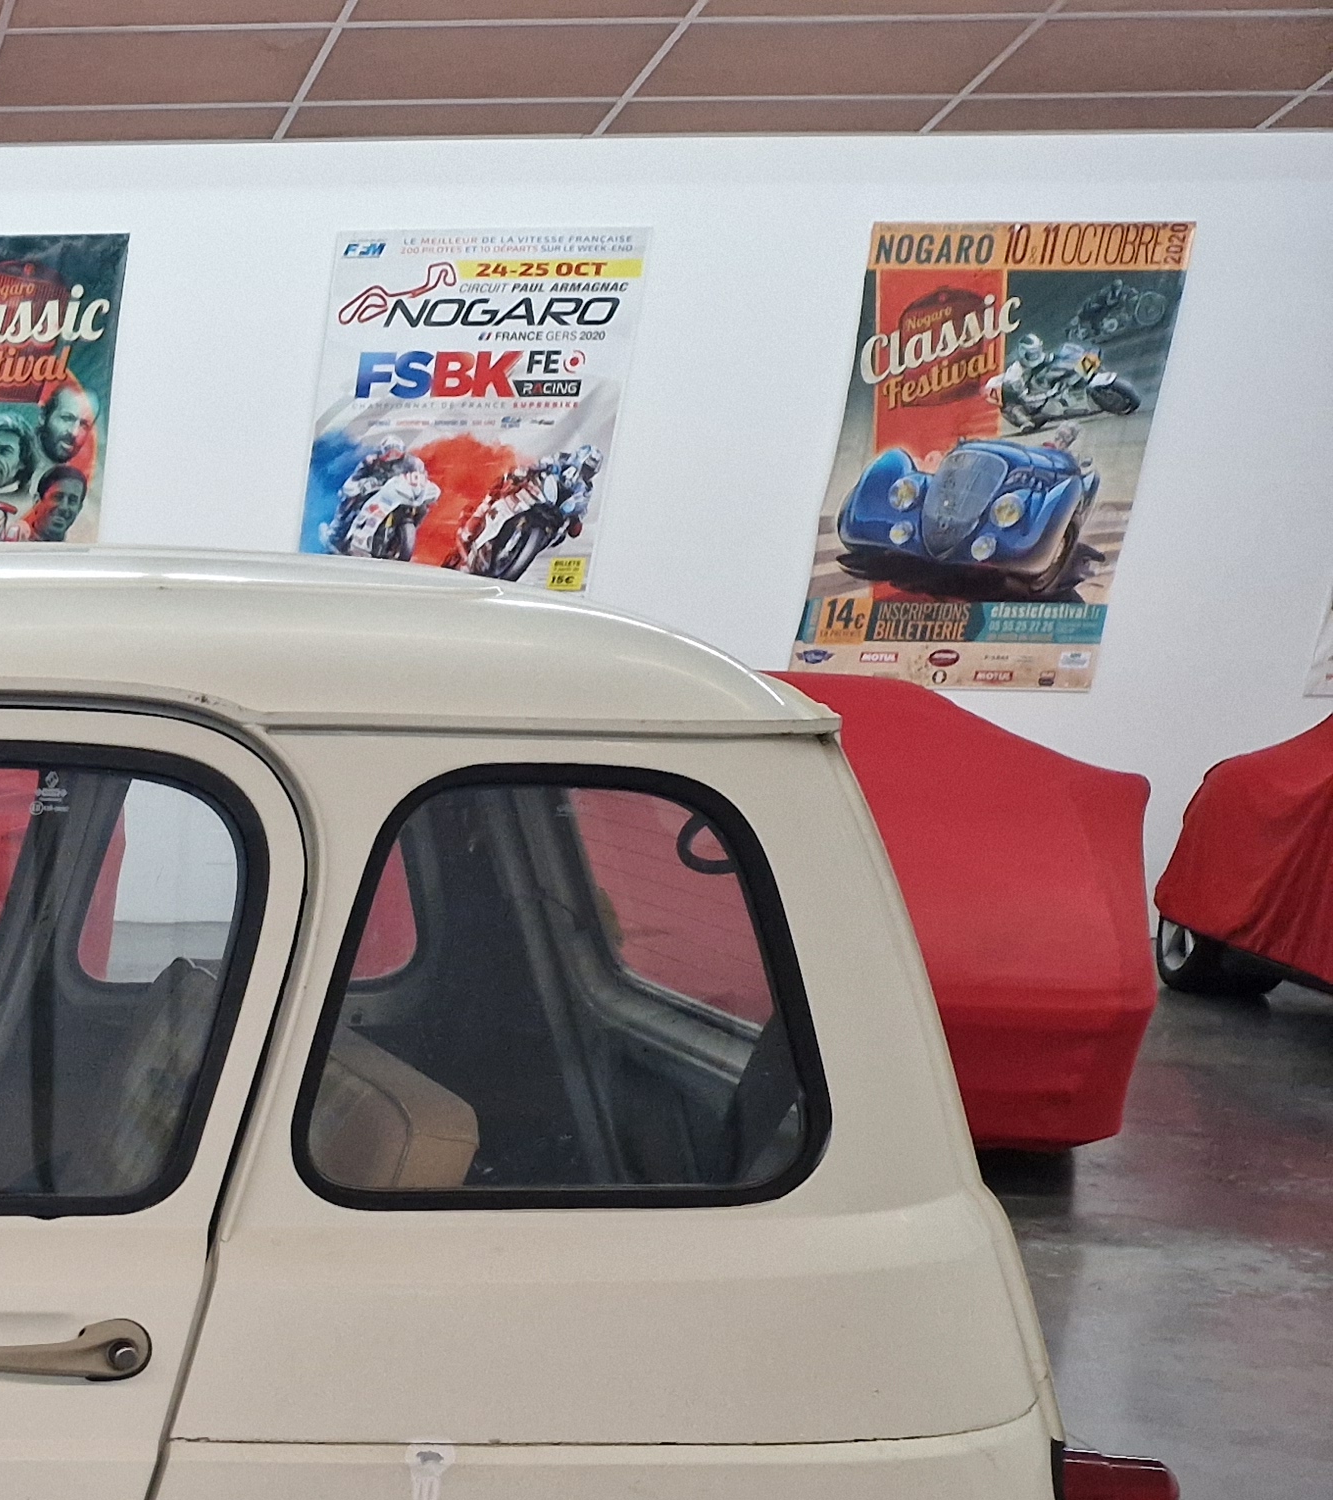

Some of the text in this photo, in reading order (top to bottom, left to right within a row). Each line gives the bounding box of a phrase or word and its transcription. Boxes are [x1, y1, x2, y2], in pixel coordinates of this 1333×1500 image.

[421, 237, 478, 245] MEILLEUR
[568, 235, 633, 244] FRANÇAISE
[875, 233, 995, 265] NOGARO
[1061, 223, 1166, 266] OCTOBRE
[1163, 223, 1189, 265] 2020
[541, 245, 560, 253] SUR
[475, 262, 608, 278] 24-25 OCT
[459, 281, 630, 294] CIRCUIT PAUL ARMAGNAC
[383, 297, 621, 328] NOGARO
[904, 305, 953, 332] Nogaro
[494, 331, 606, 341] FRANCE GERS 2020
[860, 293, 1023, 385] Classic
[354, 350, 525, 399] FSBK
[882, 342, 999, 410] Festival
[522, 382, 578, 395] RACING
[351, 402, 435, 410] CHAMPIONNAT
[877, 602, 972, 622] INSCRIPTIONS
[873, 620, 968, 641] BILLETTERIE
[861, 653, 897, 662] MOTUL
[976, 672, 1012, 682] MOTUL
